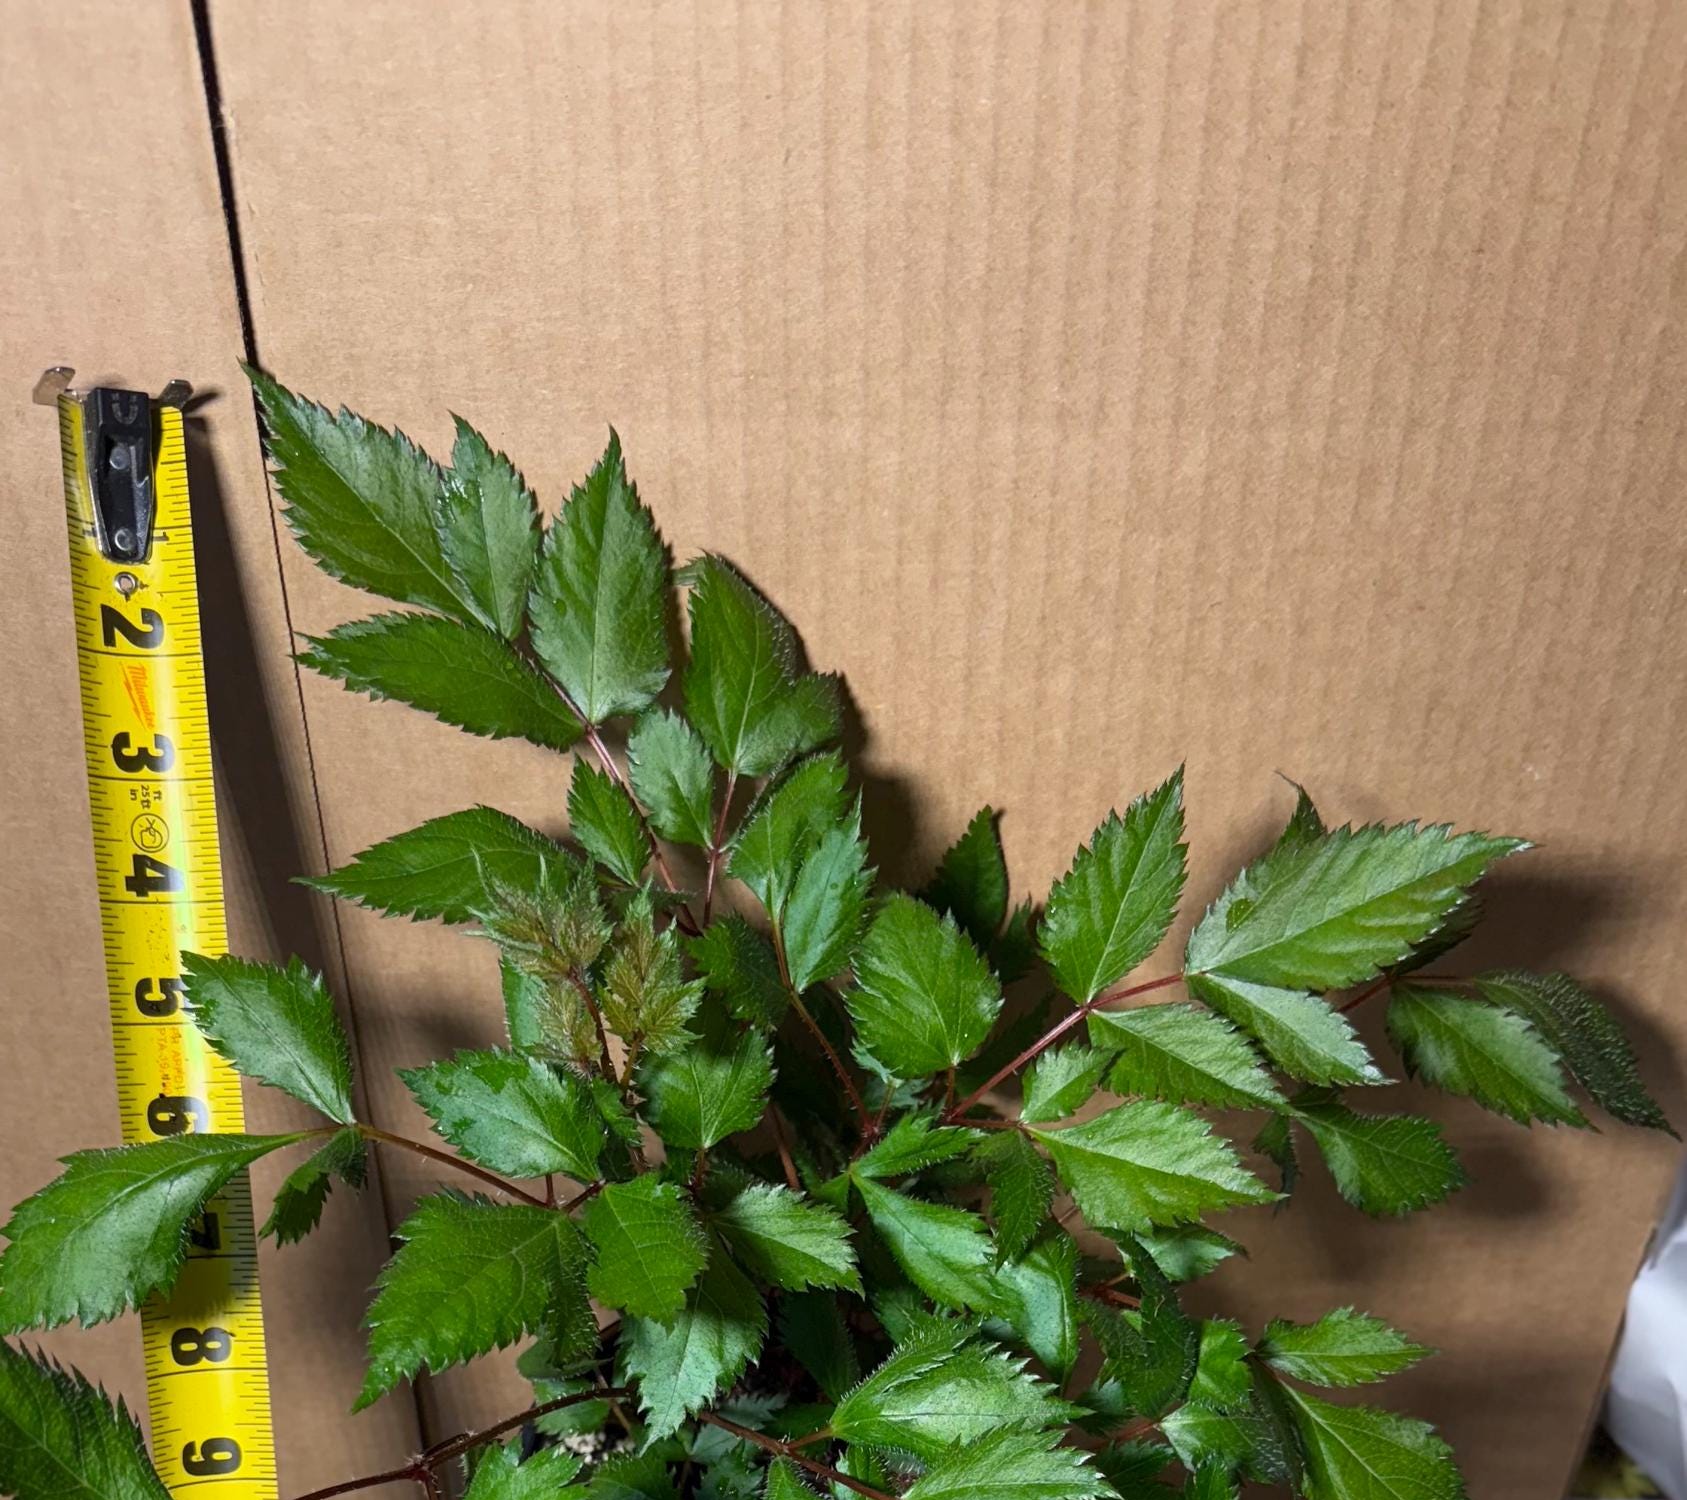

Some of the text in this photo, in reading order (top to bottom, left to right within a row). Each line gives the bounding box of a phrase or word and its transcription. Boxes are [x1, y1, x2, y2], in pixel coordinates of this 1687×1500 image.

[101, 604, 164, 649] 2
[112, 732, 175, 773] 3
[130, 789, 138, 801] in
[125, 854, 184, 897] 4
[135, 977, 196, 1017] 5
[147, 1096, 208, 1136] 6
[171, 1327, 231, 1366] 8
[182, 1437, 242, 1476] 9
